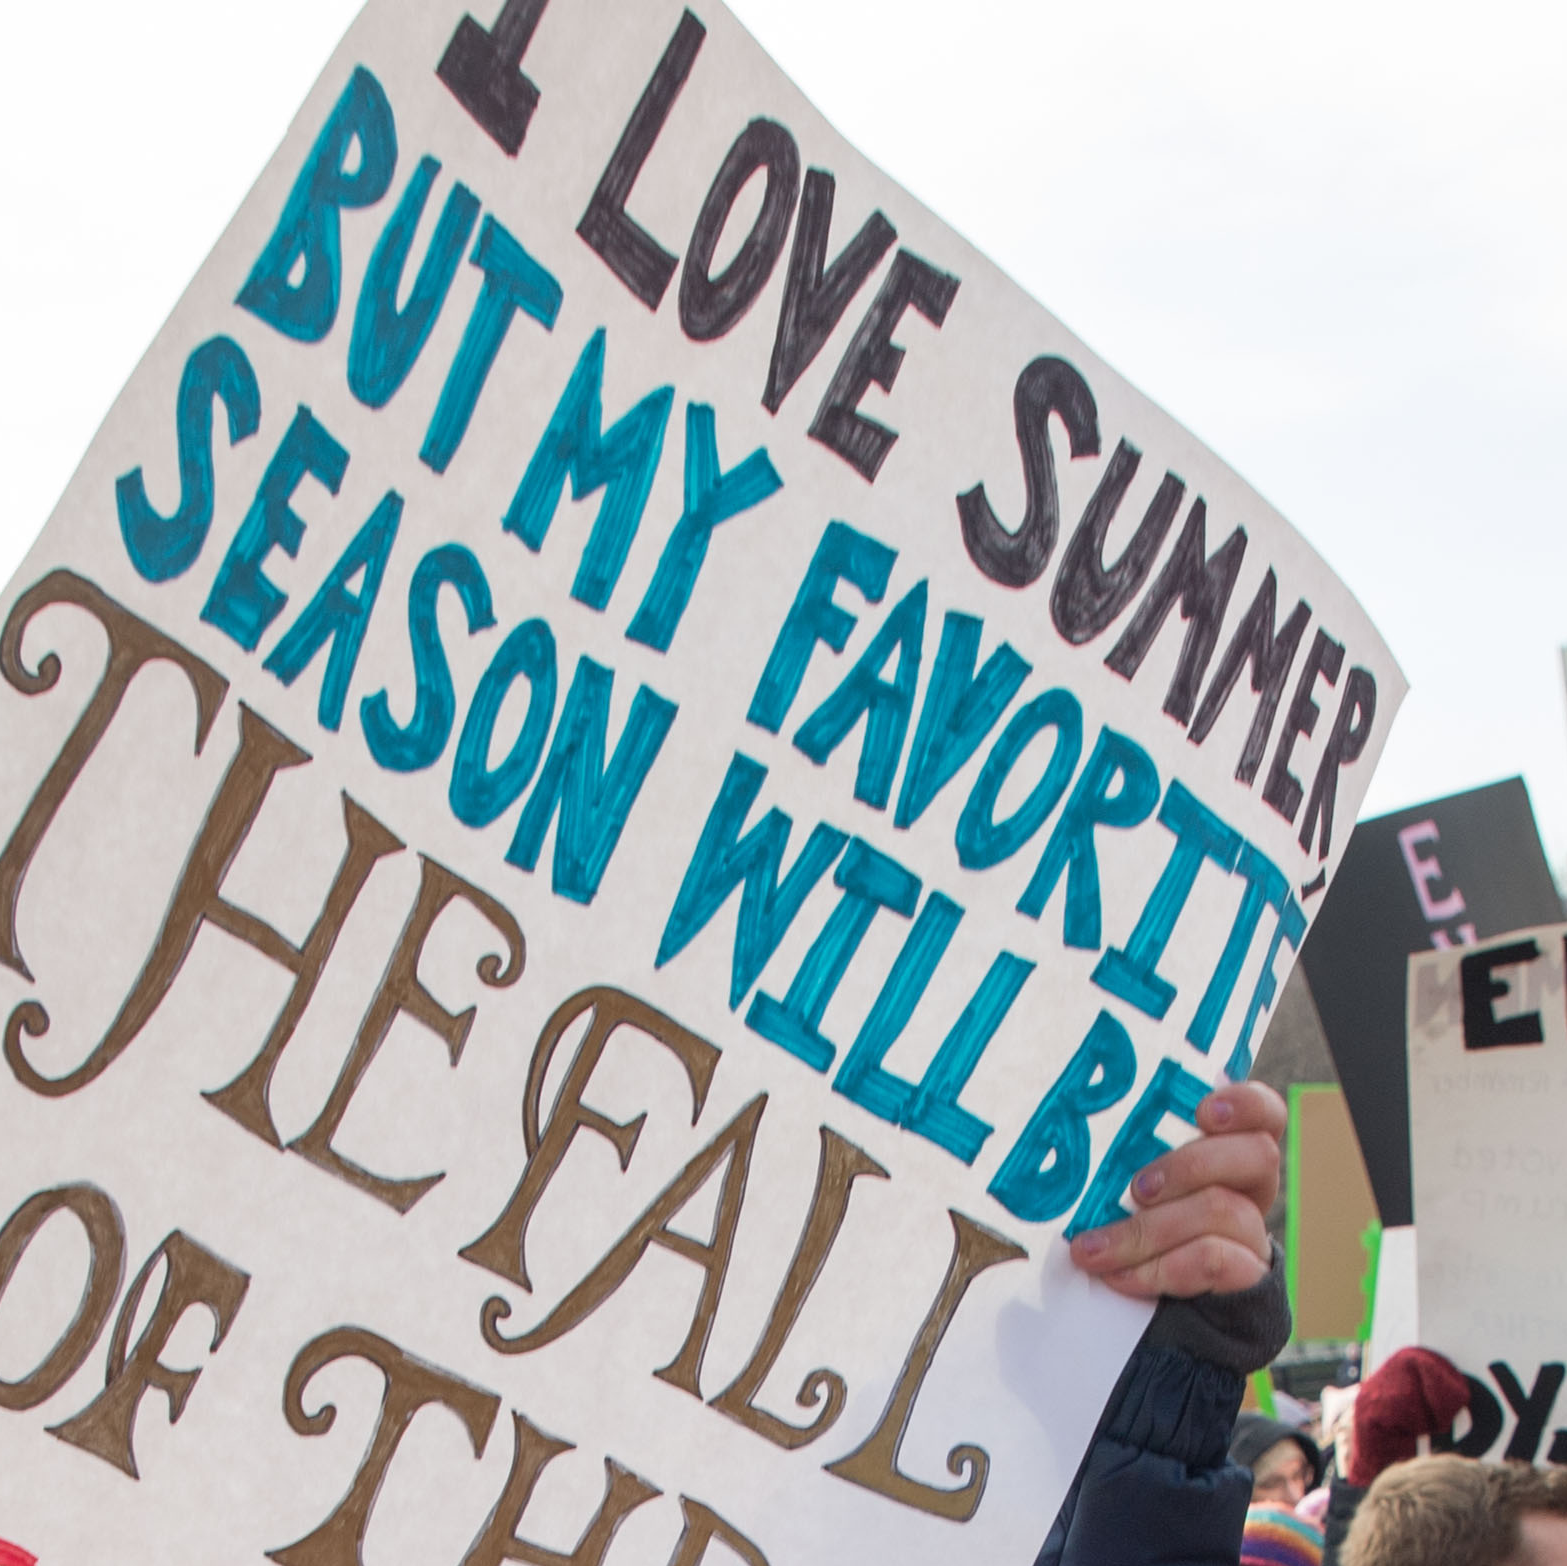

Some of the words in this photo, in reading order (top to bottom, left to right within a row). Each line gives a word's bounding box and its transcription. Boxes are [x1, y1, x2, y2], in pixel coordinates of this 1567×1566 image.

[235, 64, 563, 474] BUT
[502, 327, 783, 653] MY
[747, 519, 1308, 1083] FAVORITE
[576, 8, 961, 483] LOVE
[116, 335, 678, 904] SEASON
[655, 750, 1037, 1167] WILL
[987, 1010, 1216, 1238] BE
[456, 985, 1030, 1523] FALL
